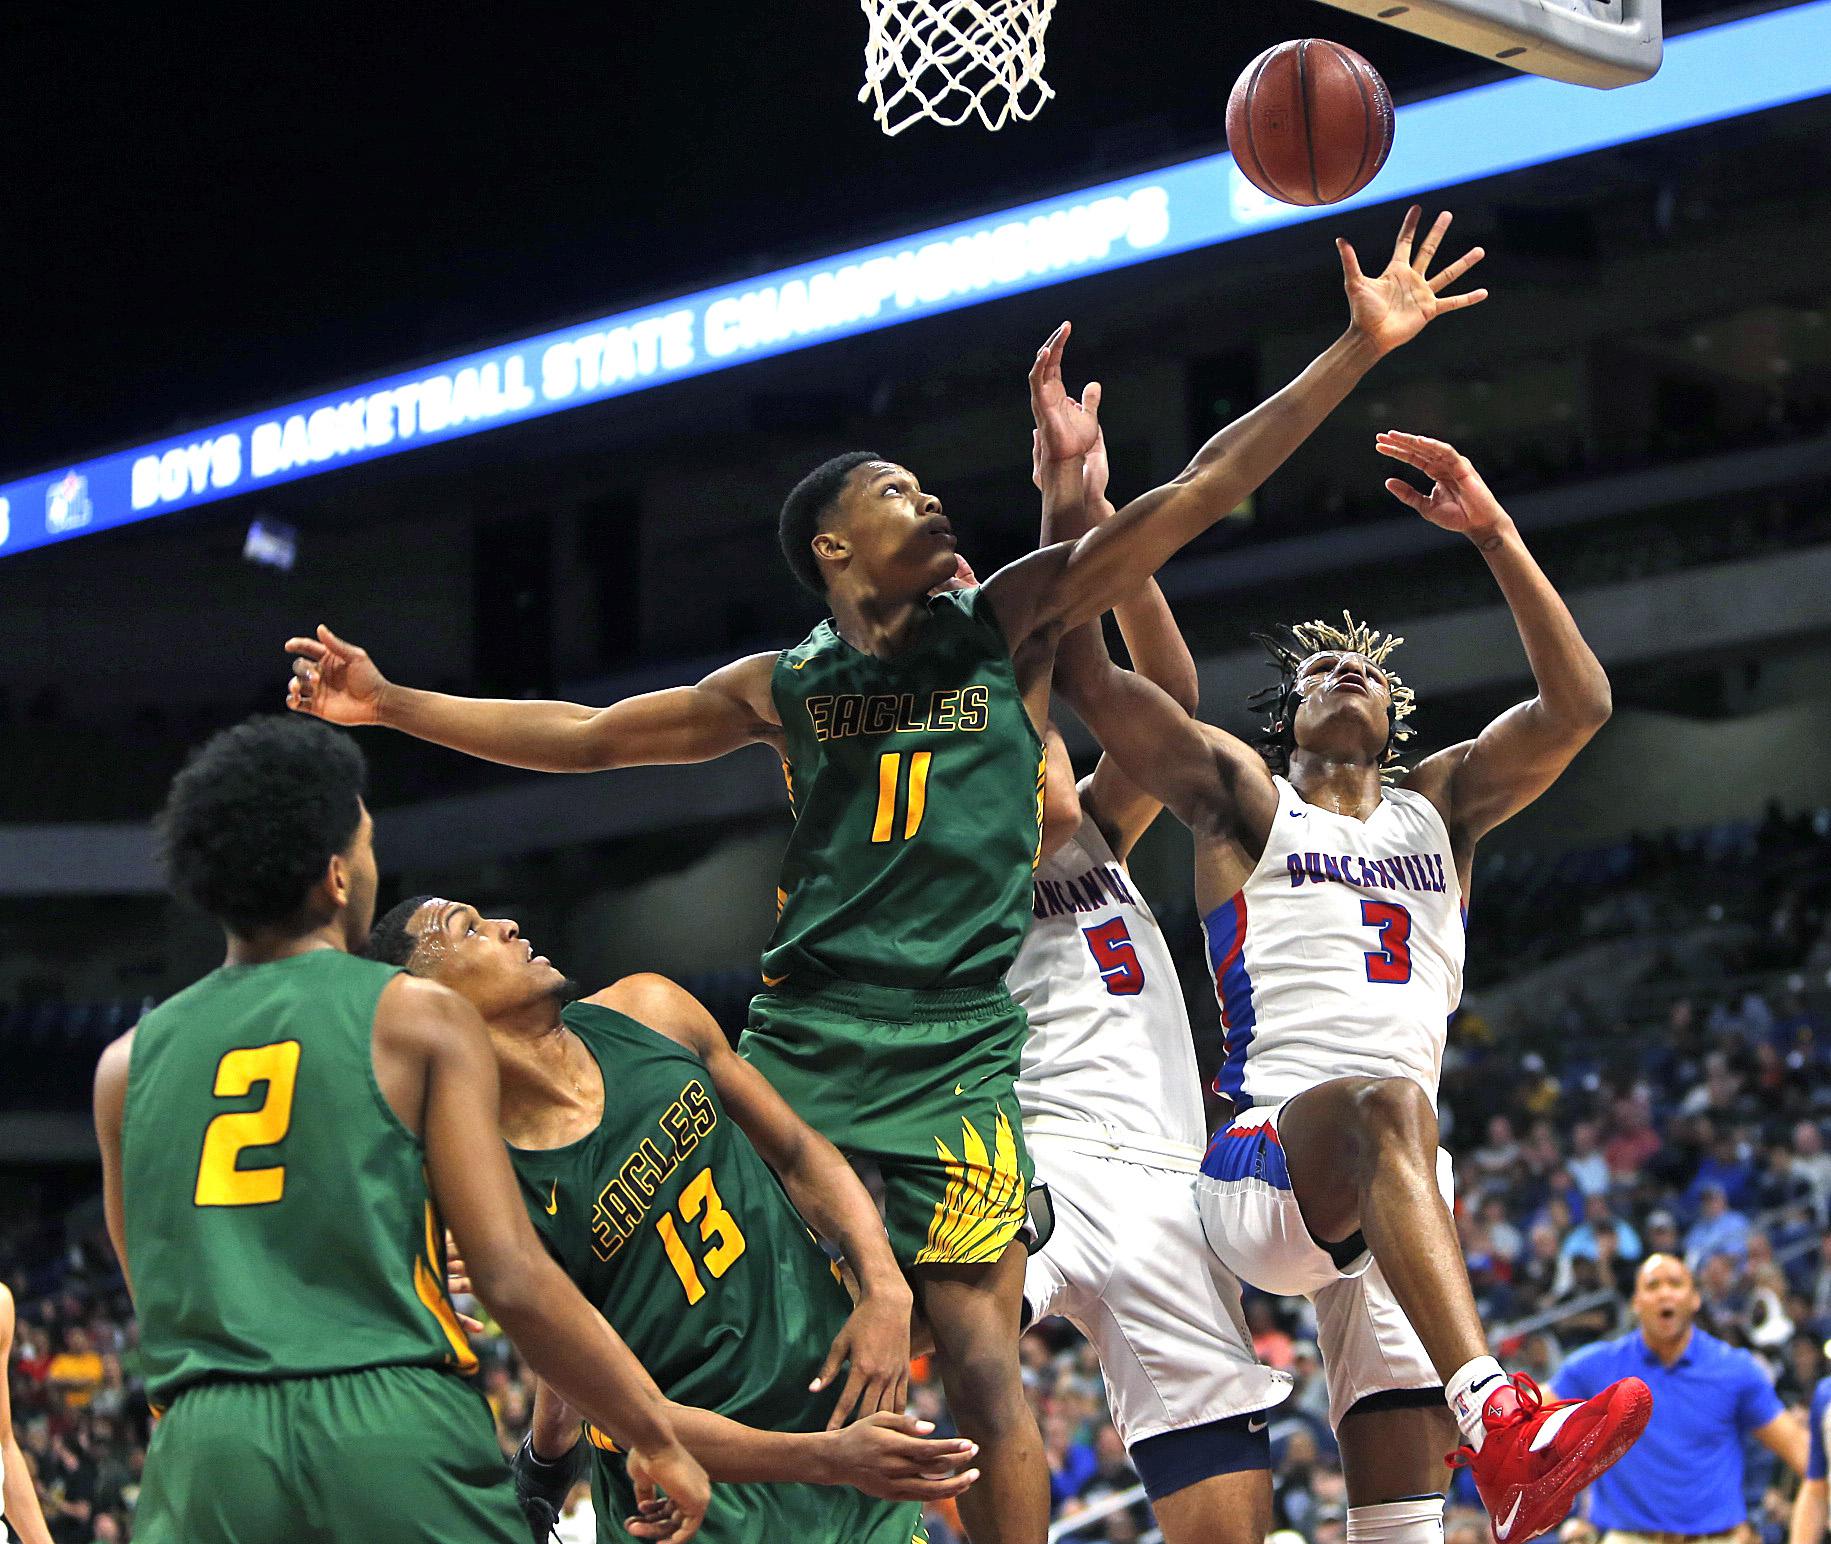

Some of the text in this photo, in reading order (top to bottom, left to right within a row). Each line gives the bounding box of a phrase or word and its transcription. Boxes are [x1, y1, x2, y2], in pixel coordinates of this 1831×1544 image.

[131, 186, 1170, 510] BOYS BASKETBALL STATE CHAMPIONSHIPS
[806, 685, 989, 742] EAGLES
[870, 751, 933, 843] 11
[1287, 852, 1447, 893] DUNCANVILLE
[1082, 915, 1145, 996] 5
[1360, 899, 1413, 984] 3
[194, 1039, 301, 1207] 2
[591, 1079, 717, 1262] EAGLES
[655, 1167, 746, 1306] 13
